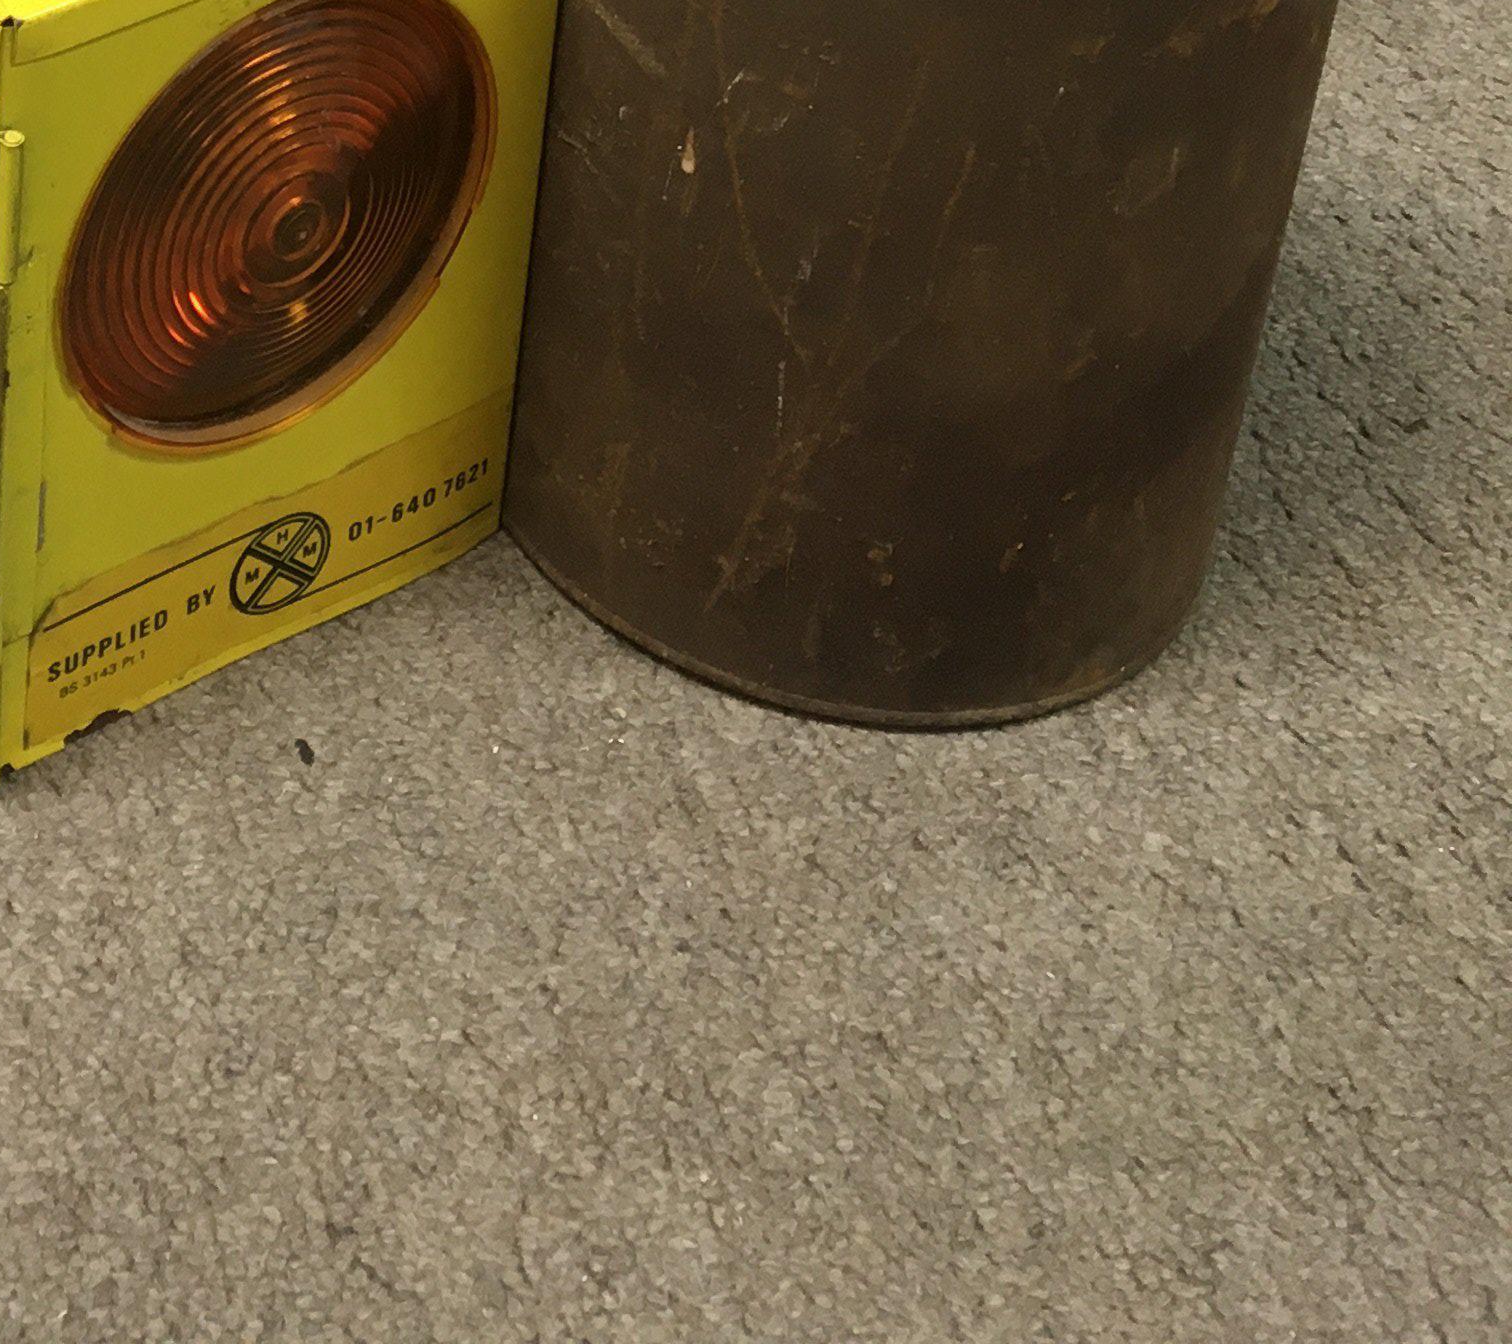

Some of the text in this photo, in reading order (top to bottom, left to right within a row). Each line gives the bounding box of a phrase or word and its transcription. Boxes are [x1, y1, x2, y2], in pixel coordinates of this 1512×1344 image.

[47, 608, 169, 683] SUPPLIED
[185, 583, 217, 617] BY
[347, 487, 437, 542] 01-640
